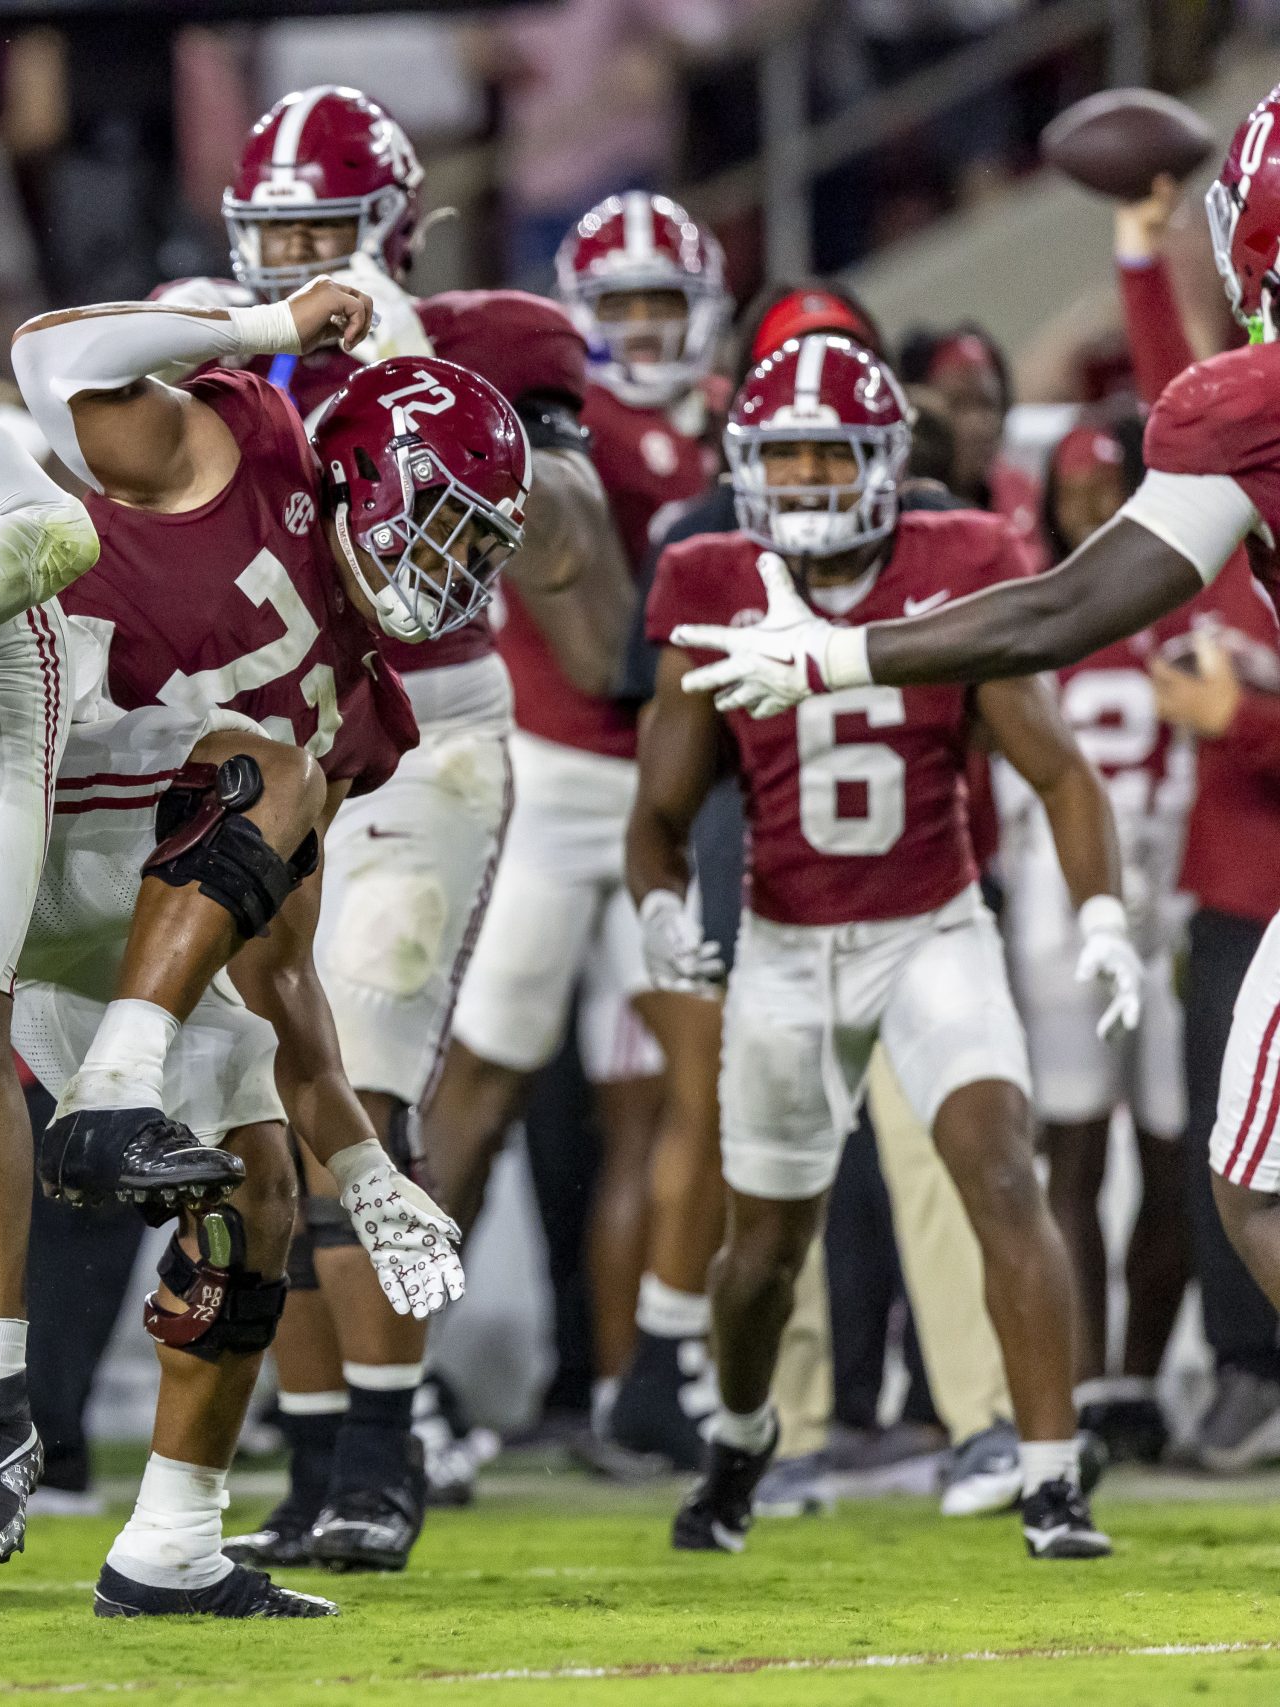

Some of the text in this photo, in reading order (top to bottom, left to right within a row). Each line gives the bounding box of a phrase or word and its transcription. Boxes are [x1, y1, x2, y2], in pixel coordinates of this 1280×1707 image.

[1240, 112, 1274, 175] 0
[377, 370, 456, 432] 72
[284, 491, 315, 535] SEC
[796, 685, 906, 856] 6
[193, 1305, 214, 1321] 72
